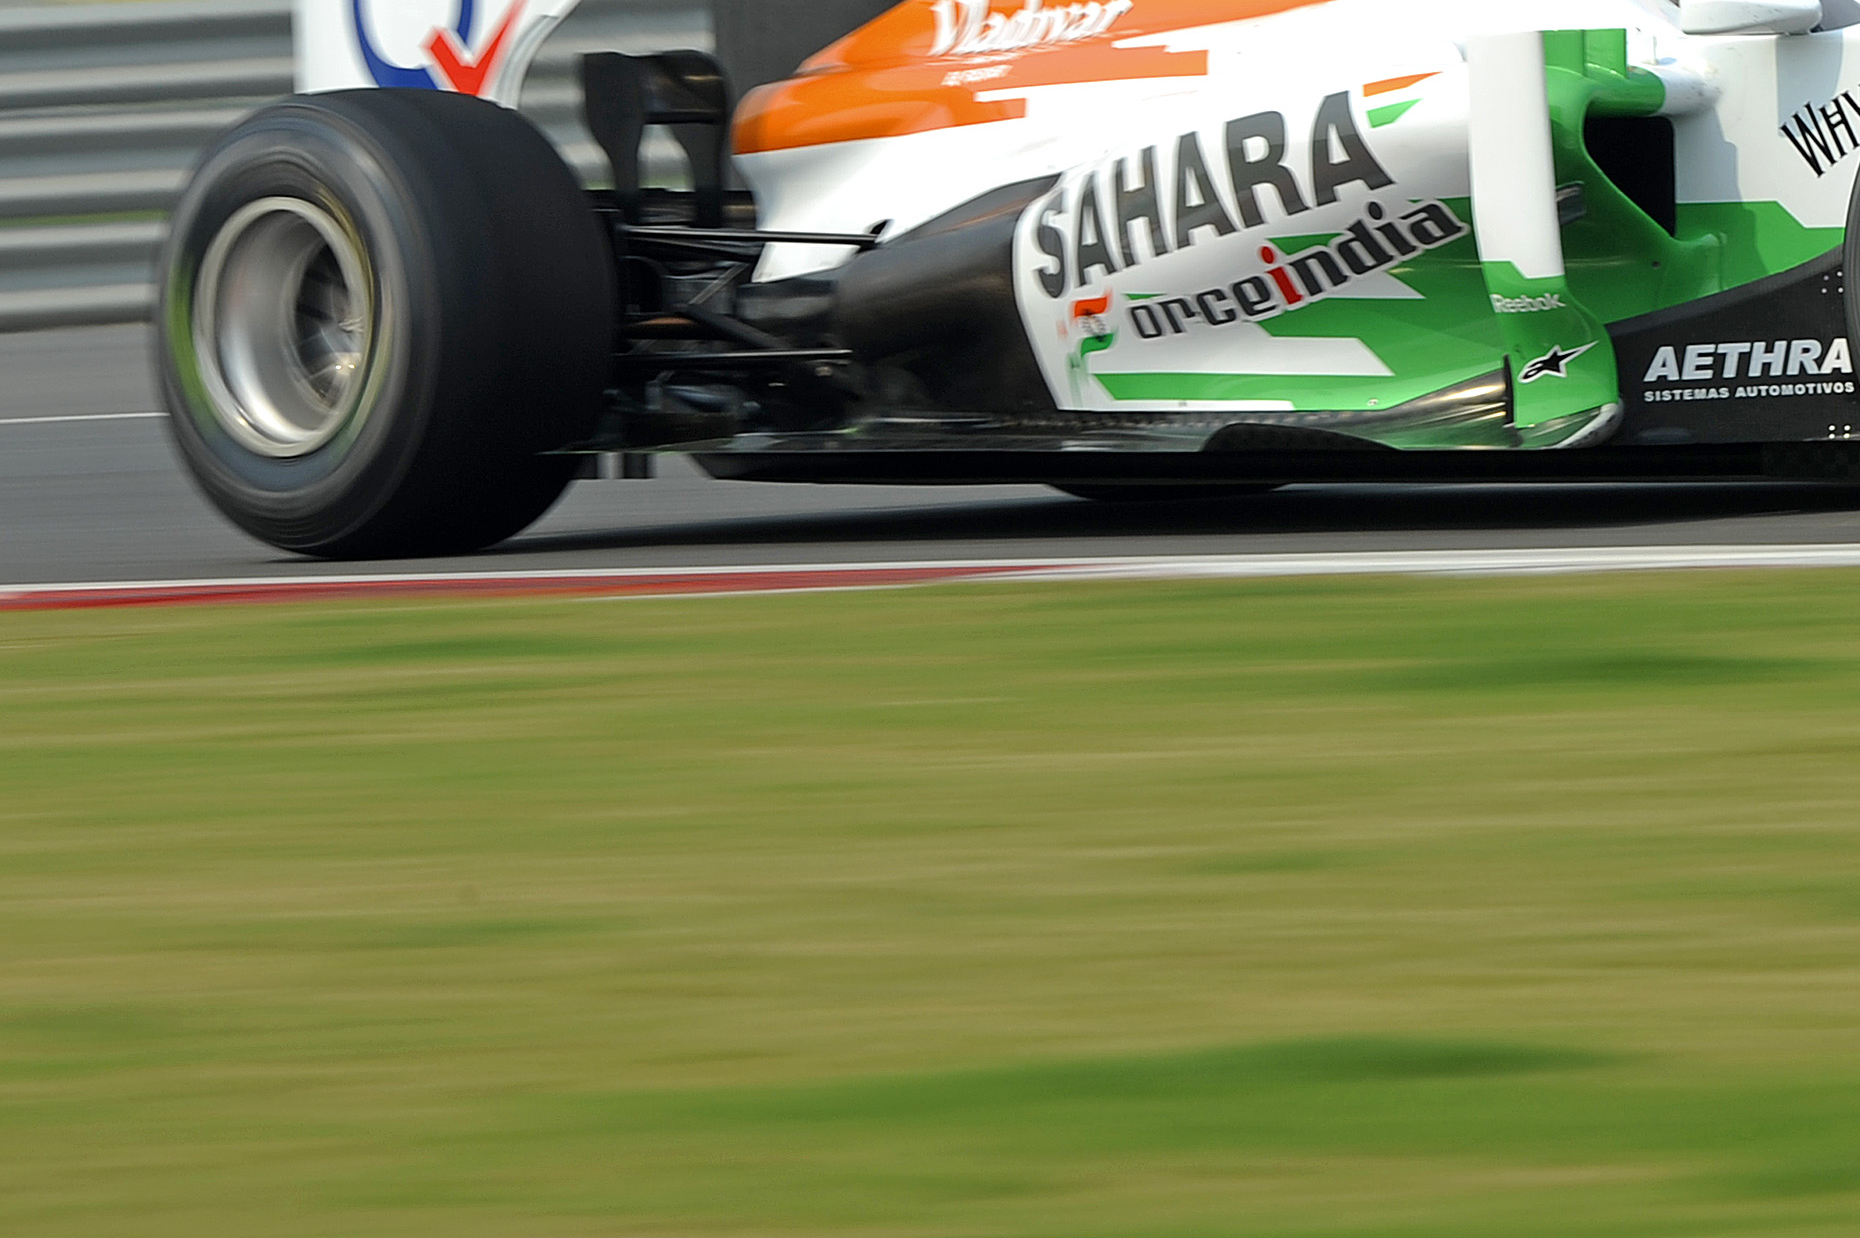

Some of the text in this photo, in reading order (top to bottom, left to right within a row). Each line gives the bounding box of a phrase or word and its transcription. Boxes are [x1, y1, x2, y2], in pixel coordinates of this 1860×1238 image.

[1033, 90, 1397, 299] SAHARA
[1491, 292, 1567, 313] Reebok
[1643, 337, 1854, 383] AETHRA
[1643, 381, 1856, 403] SISTEMAS AUTOMOTIVOS
